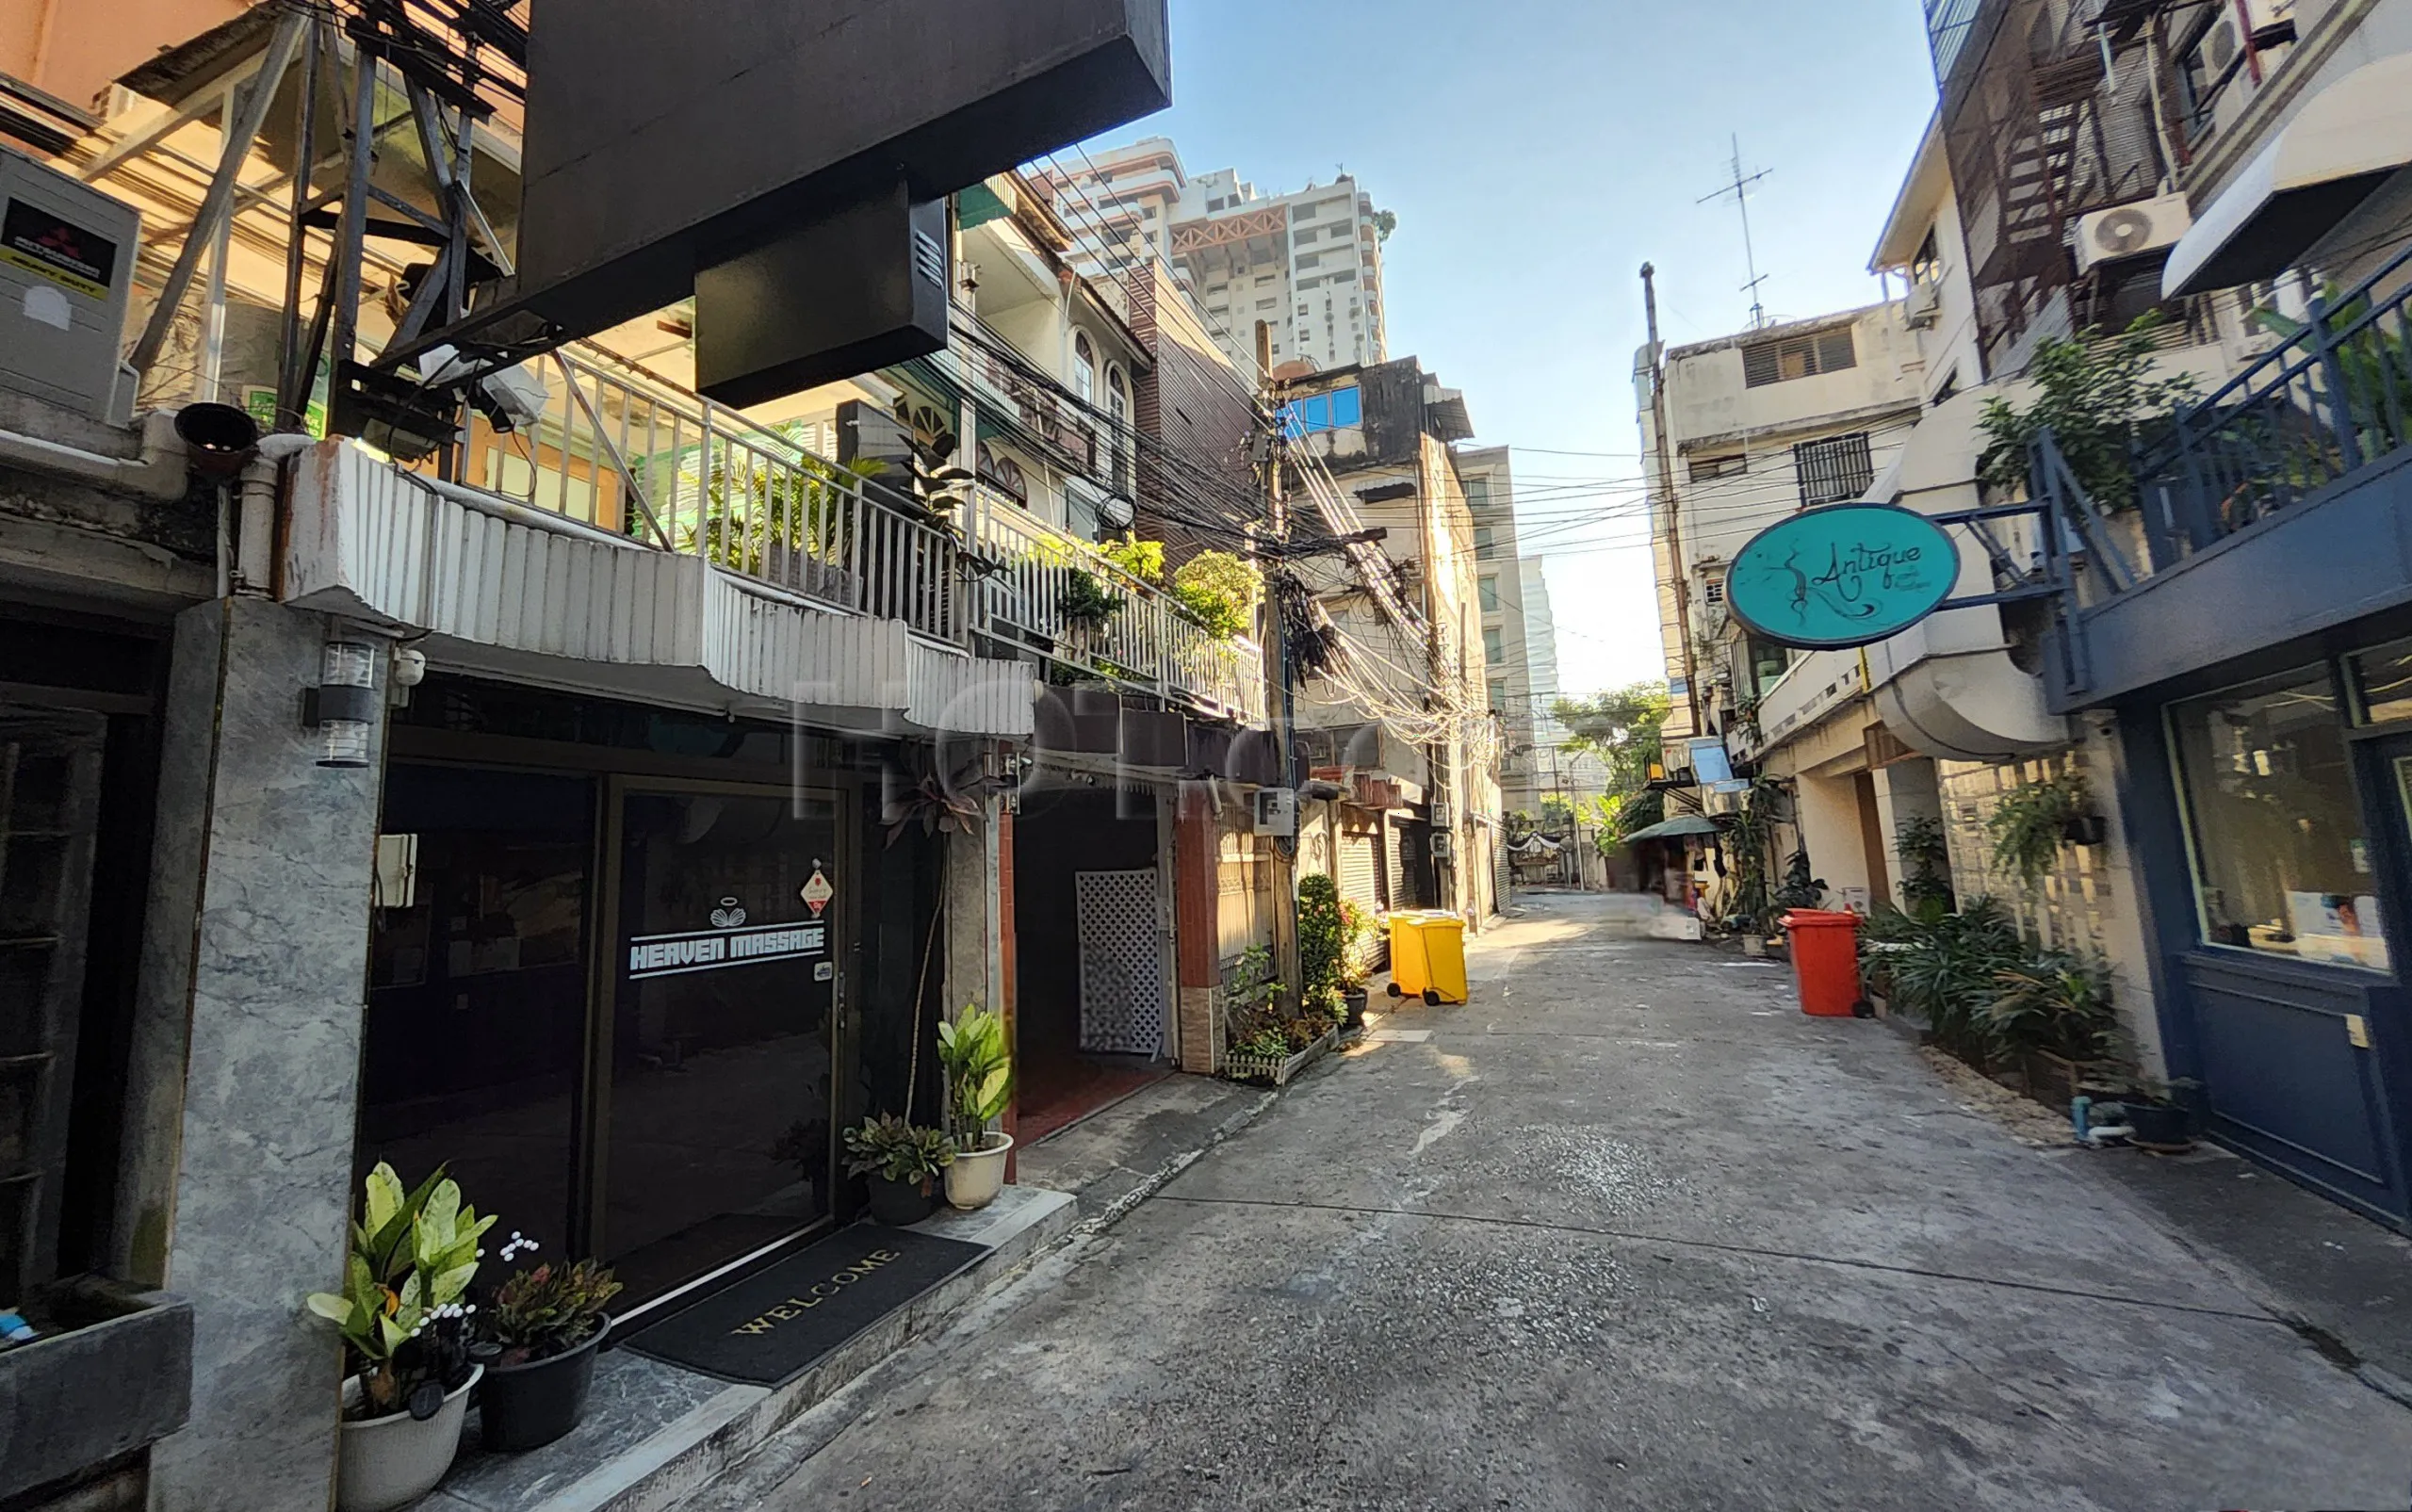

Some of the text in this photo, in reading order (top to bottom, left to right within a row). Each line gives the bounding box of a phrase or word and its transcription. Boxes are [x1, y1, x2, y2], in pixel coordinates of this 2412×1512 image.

[1811, 542, 1921, 603] Antique
[629, 927, 825, 971] HEAVEN MASSAGE
[730, 1248, 902, 1335] WELCOME
